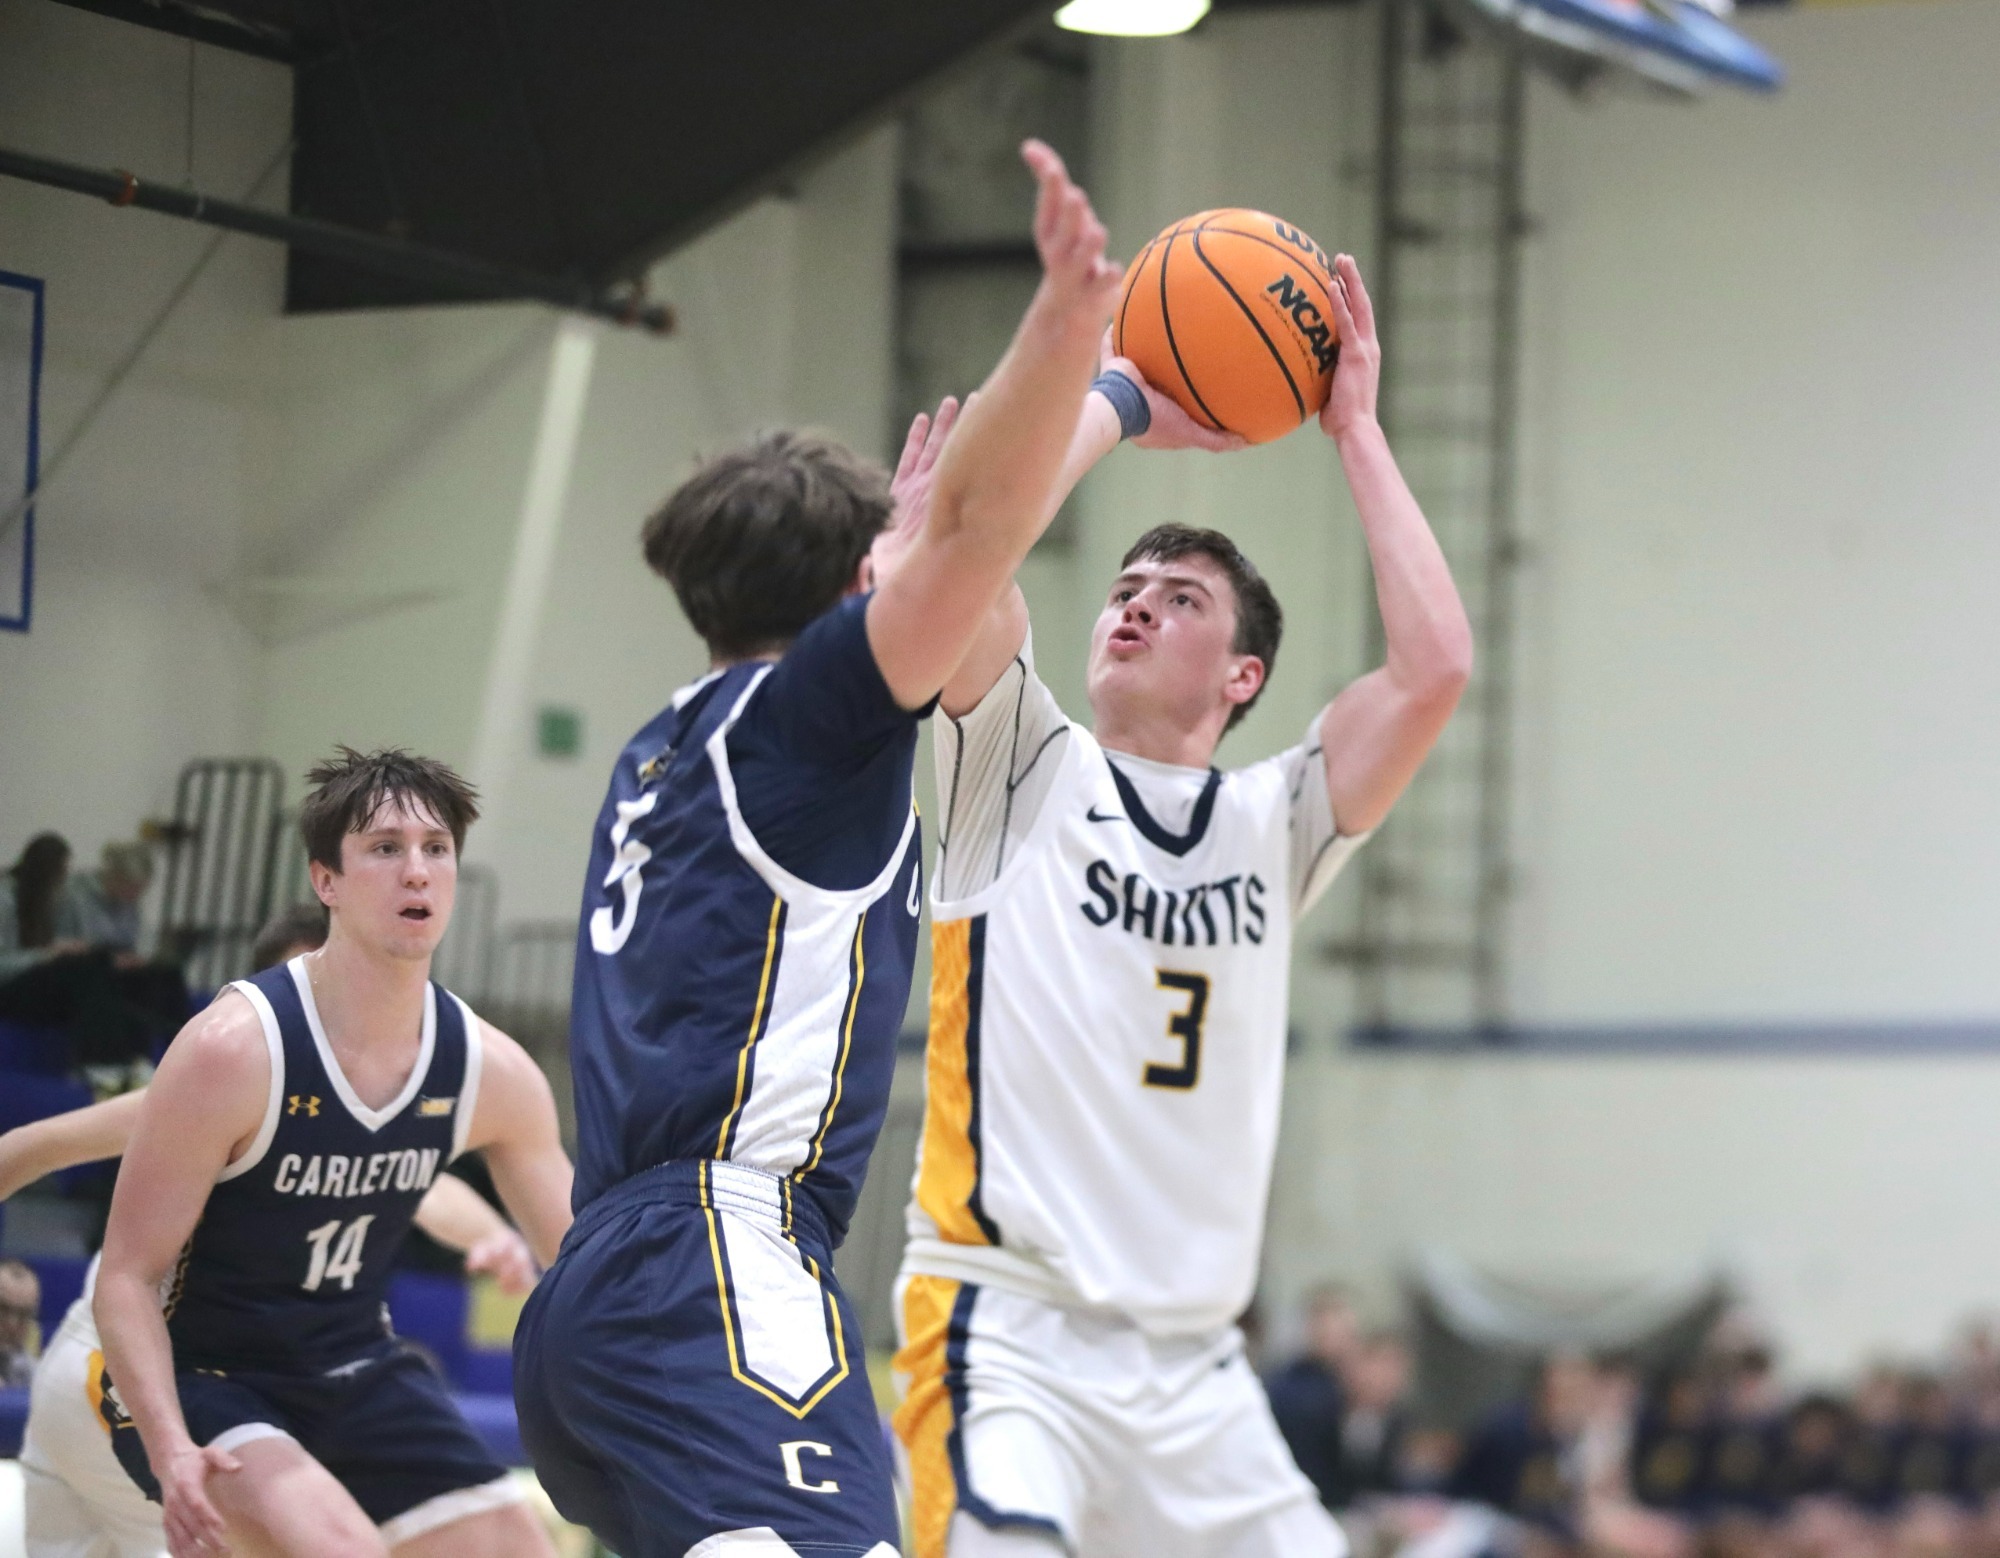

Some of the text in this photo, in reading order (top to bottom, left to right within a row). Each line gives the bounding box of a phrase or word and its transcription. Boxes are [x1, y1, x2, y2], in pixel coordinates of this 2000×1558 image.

[1266, 273, 1339, 375] NCAA
[590, 790, 658, 956] 5
[1142, 966, 1213, 1093] 3
[273, 1148, 441, 1197] CARLETON
[302, 1214, 376, 1291] 14
[778, 1440, 841, 1494] C
